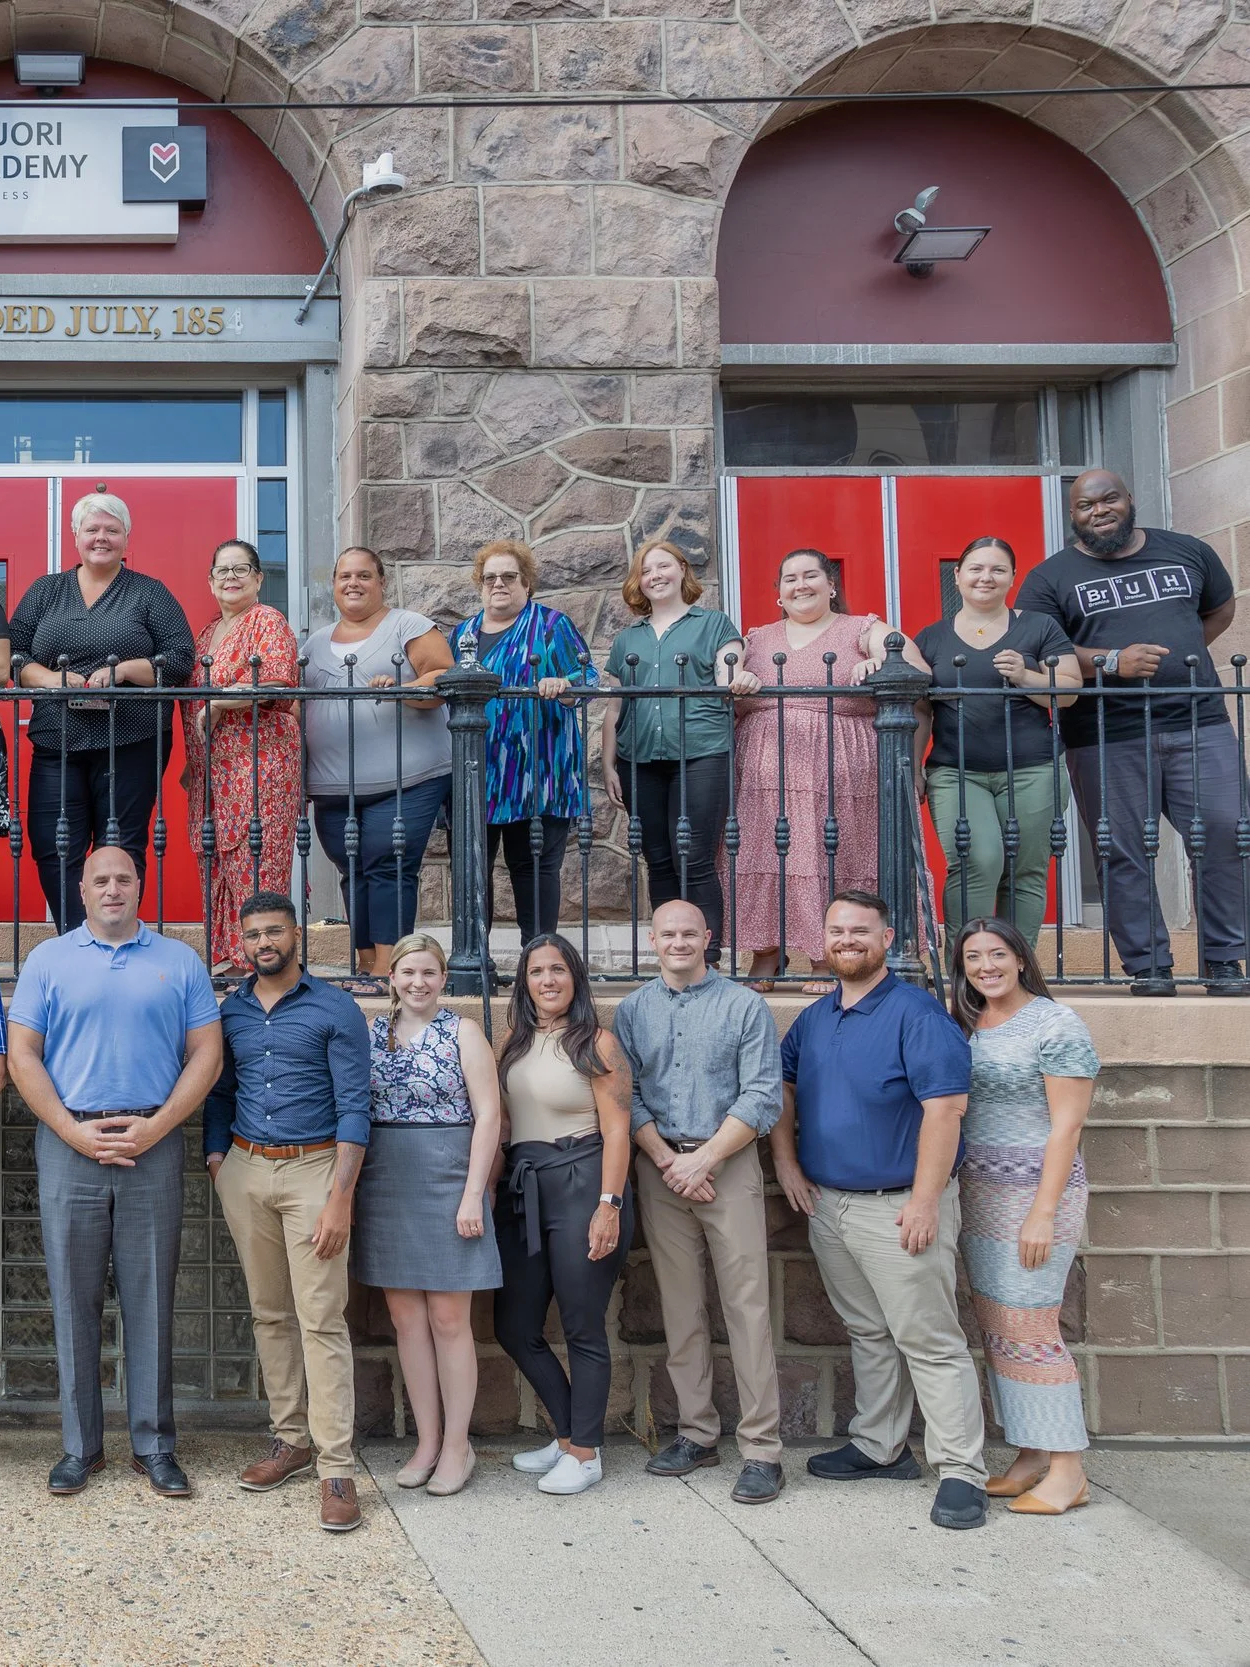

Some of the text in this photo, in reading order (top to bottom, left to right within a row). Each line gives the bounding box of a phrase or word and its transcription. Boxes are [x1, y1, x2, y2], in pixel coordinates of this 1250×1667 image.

[65, 305, 161, 340] JULY,
[1086, 574, 1180, 603] Br U H
[1088, 599, 1110, 608] Bromine
